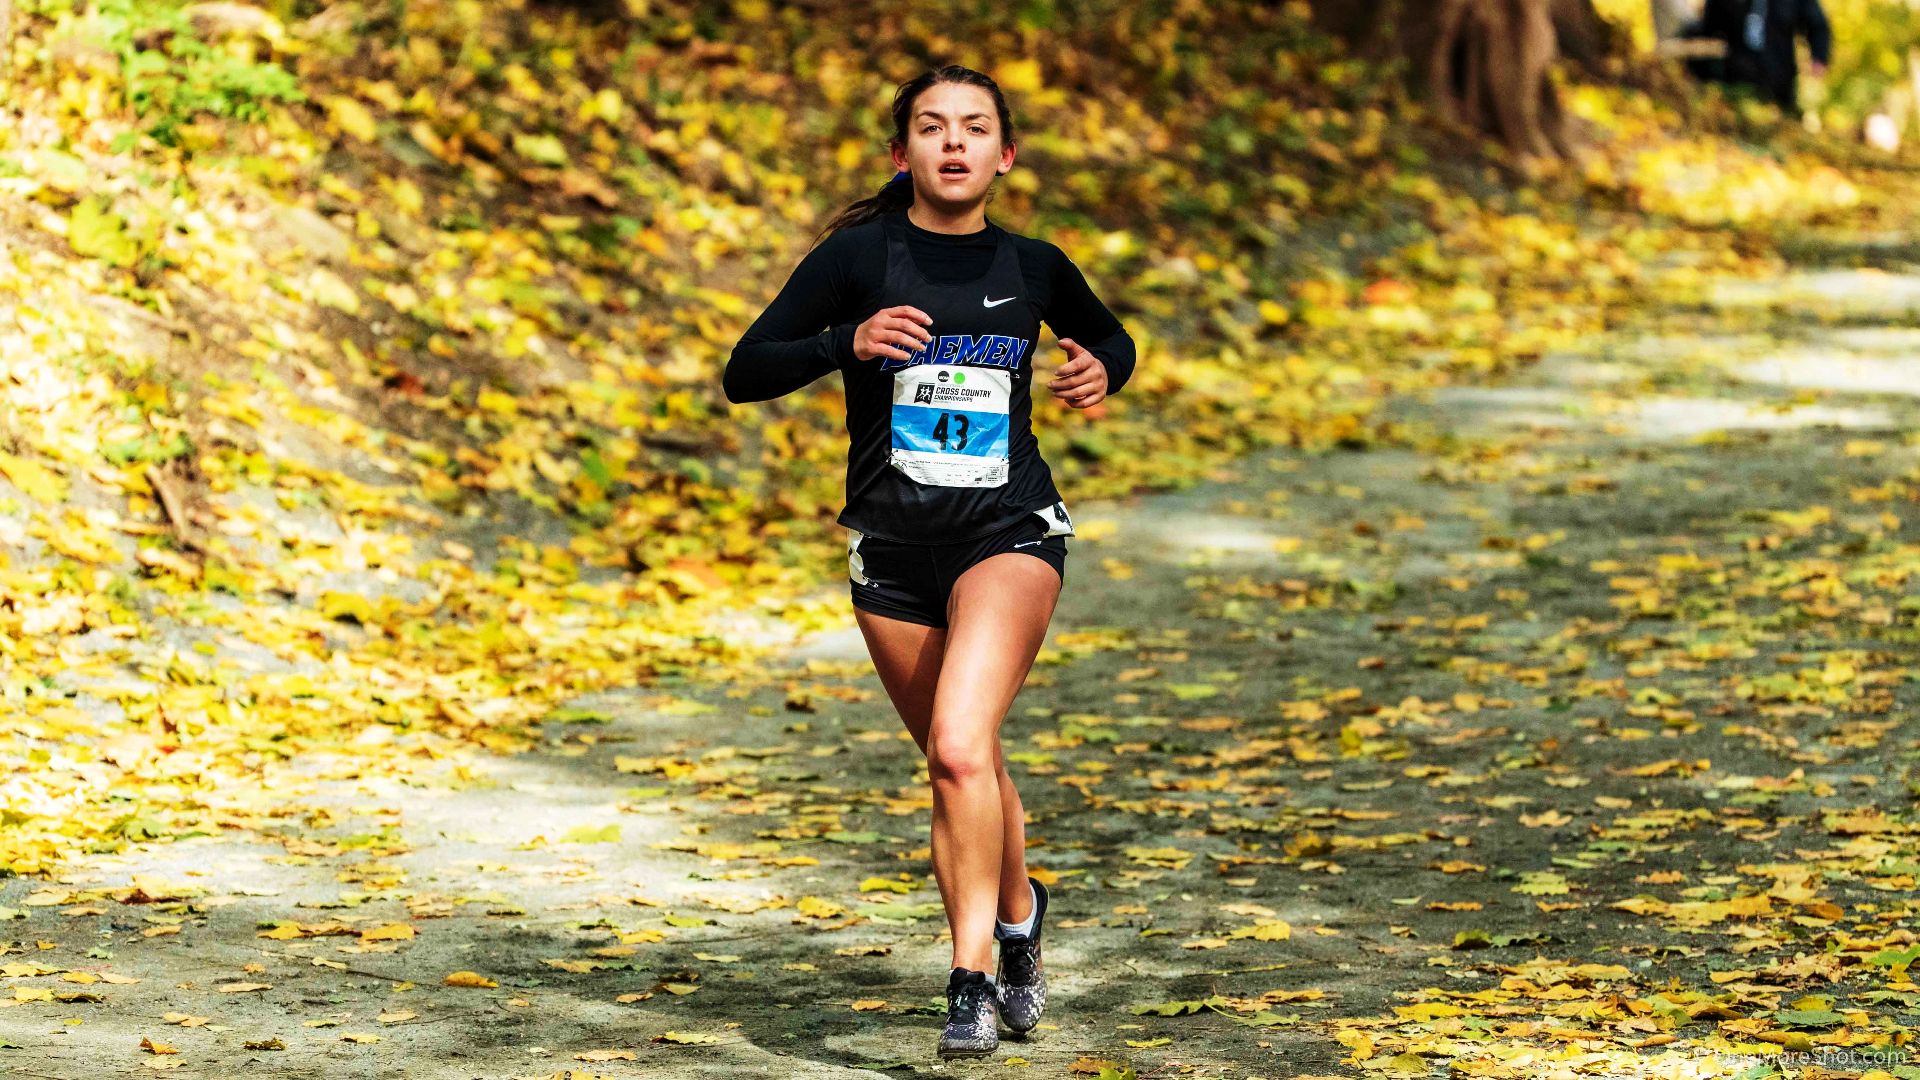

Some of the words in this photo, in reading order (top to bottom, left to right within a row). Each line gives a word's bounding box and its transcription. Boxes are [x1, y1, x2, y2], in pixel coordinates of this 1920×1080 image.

[935, 386, 959, 396] CROSS
[960, 388, 992, 398] COUNTRY
[933, 413, 969, 451] 43
